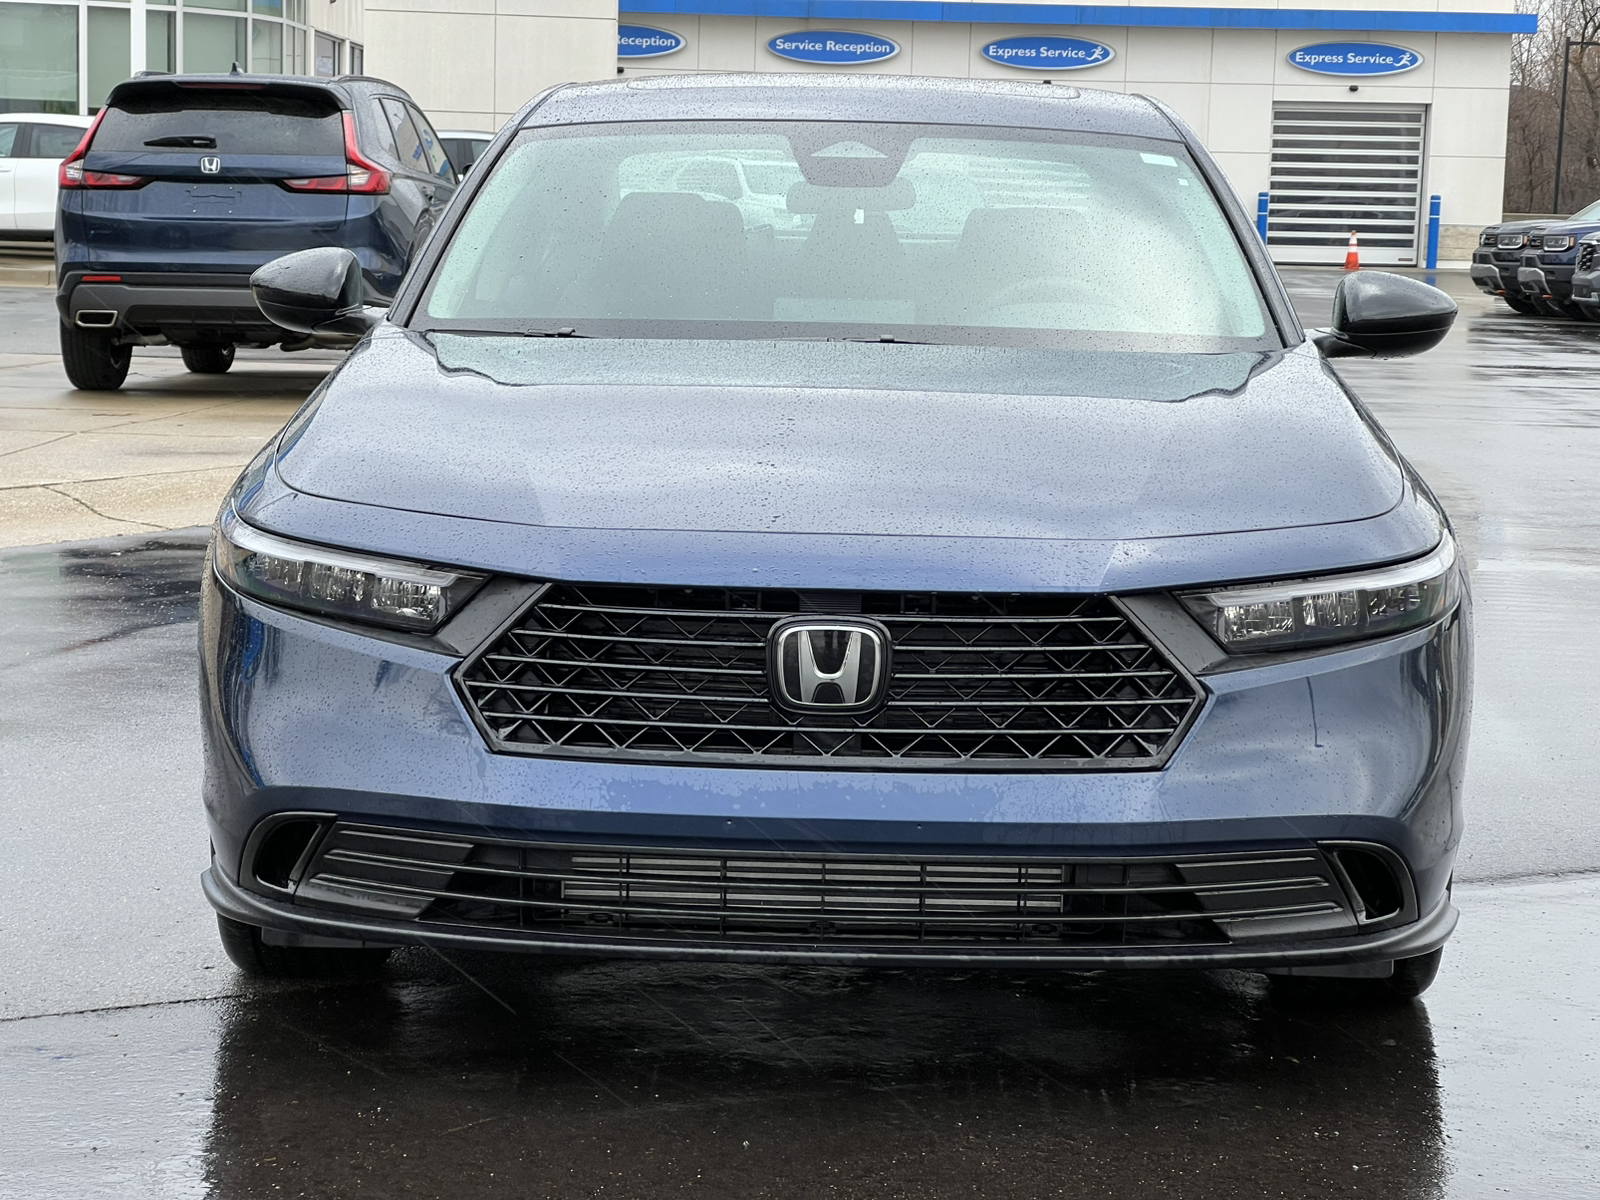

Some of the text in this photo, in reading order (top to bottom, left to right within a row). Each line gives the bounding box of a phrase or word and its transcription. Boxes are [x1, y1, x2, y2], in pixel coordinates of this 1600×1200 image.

[775, 38, 890, 55] Service Reception
[988, 45, 1086, 59] Express Service
[1295, 51, 1394, 65] Express Service
